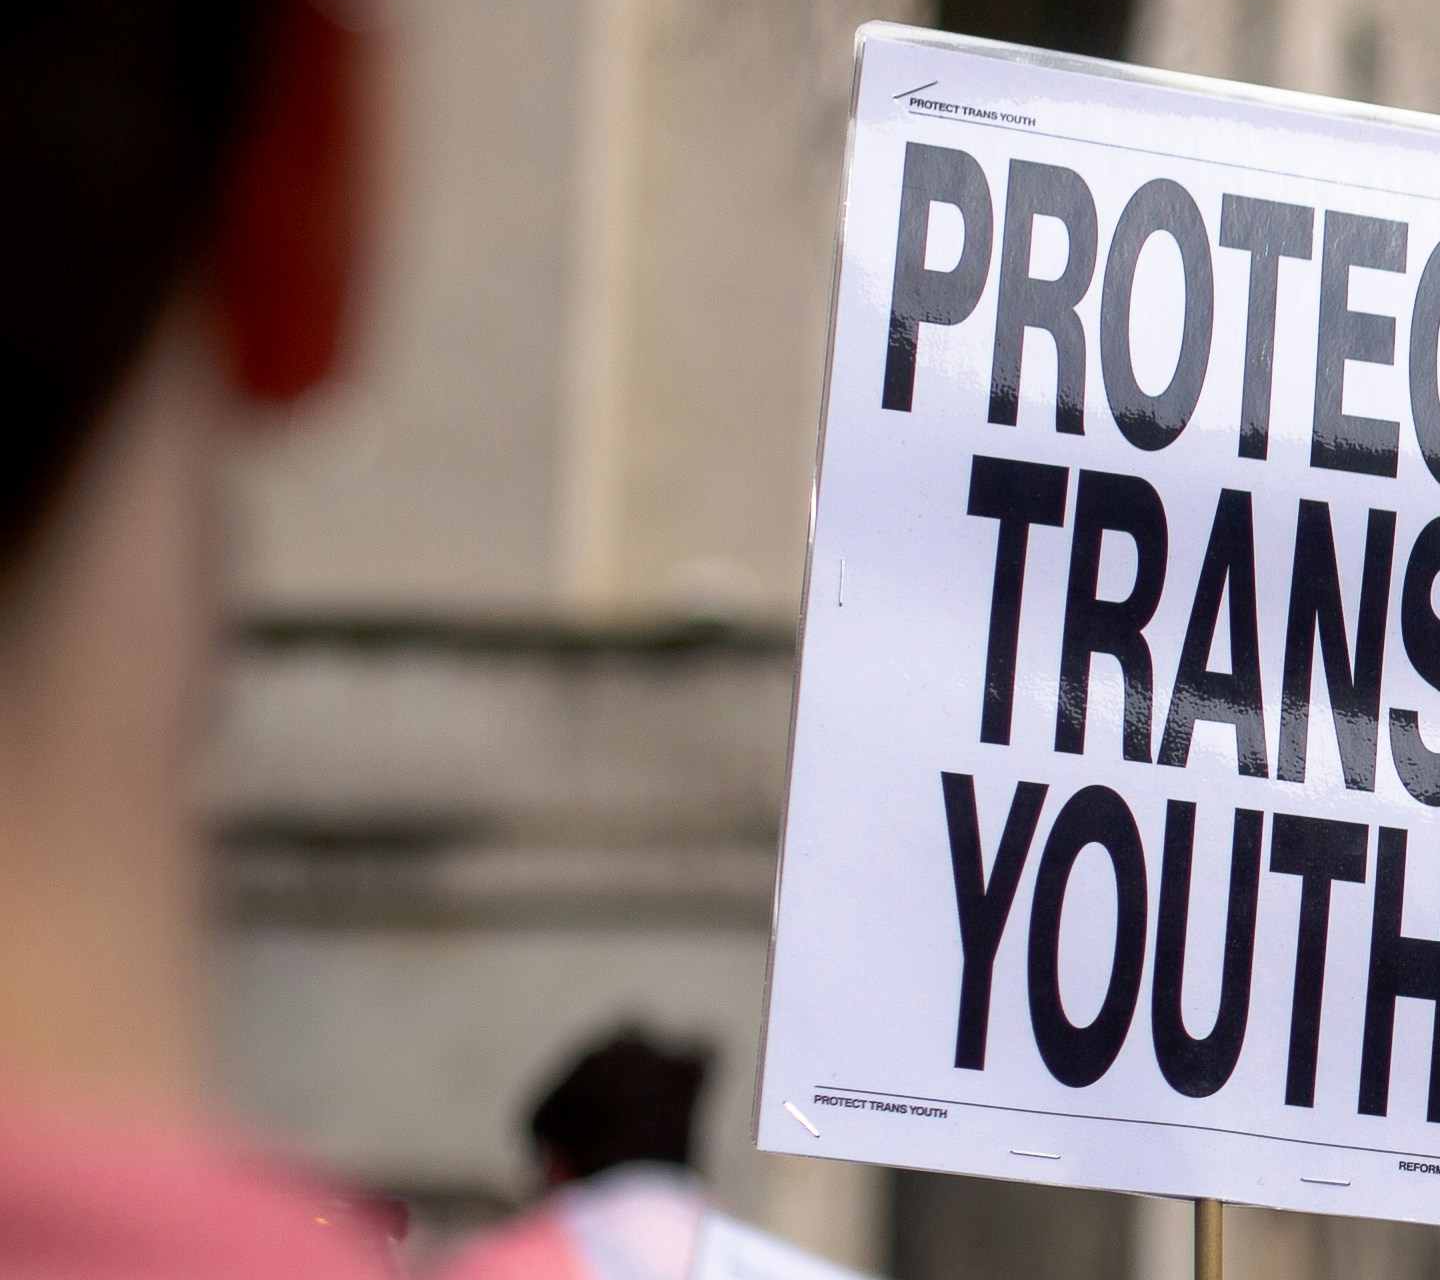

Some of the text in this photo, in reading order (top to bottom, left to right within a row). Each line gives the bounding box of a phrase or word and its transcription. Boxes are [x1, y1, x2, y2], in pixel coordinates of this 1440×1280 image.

[909, 97, 1036, 126] PROTECT TRANS YOUTH
[814, 1094, 948, 1118] PROTECT TRANS YOUTH
